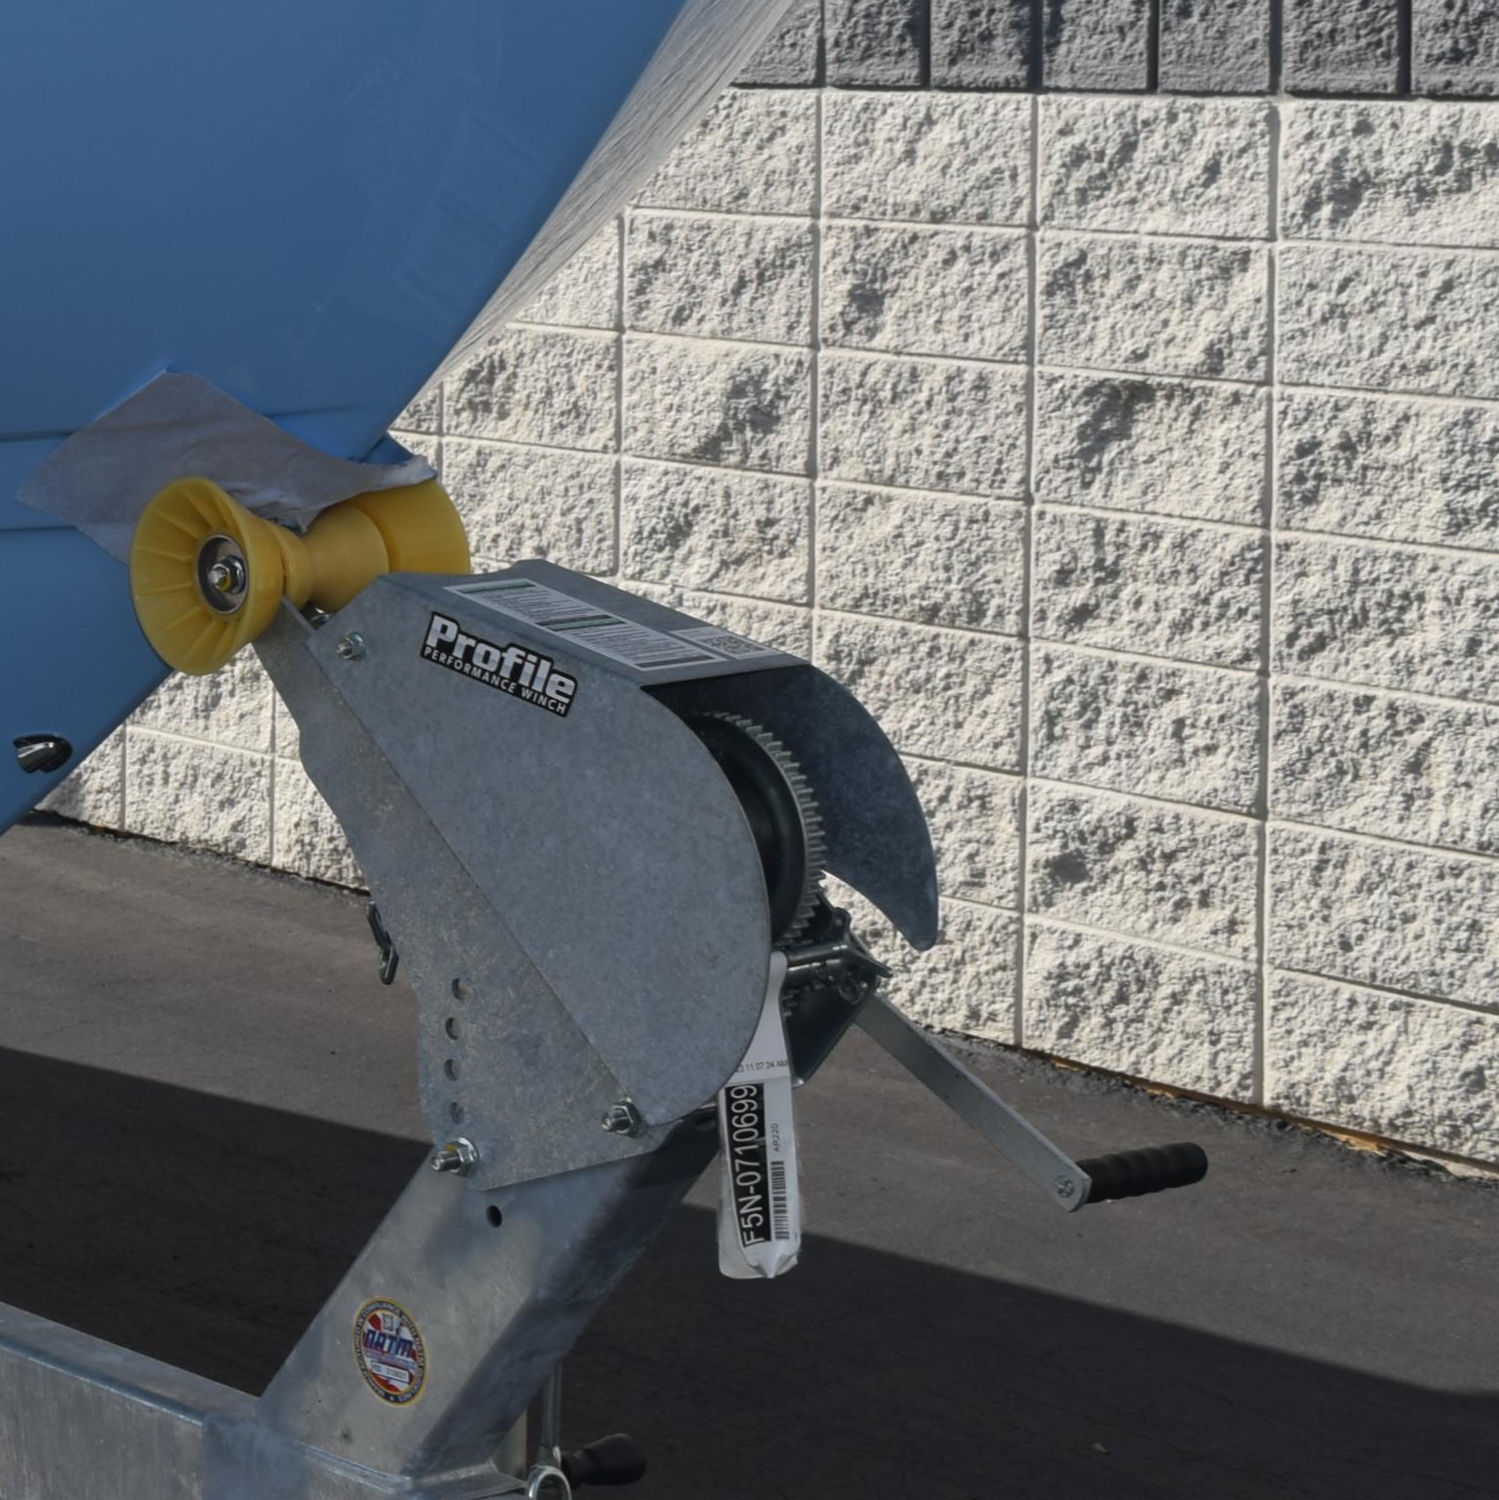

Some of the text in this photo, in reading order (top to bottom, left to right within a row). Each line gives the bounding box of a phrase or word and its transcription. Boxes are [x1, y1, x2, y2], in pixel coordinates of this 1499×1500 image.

[423, 646, 567, 716] PERFORMANCE WINCH
[426, 615, 577, 703] Profile
[730, 1084, 766, 1248] F5N-0710699
[770, 1123, 780, 1152] AR220
